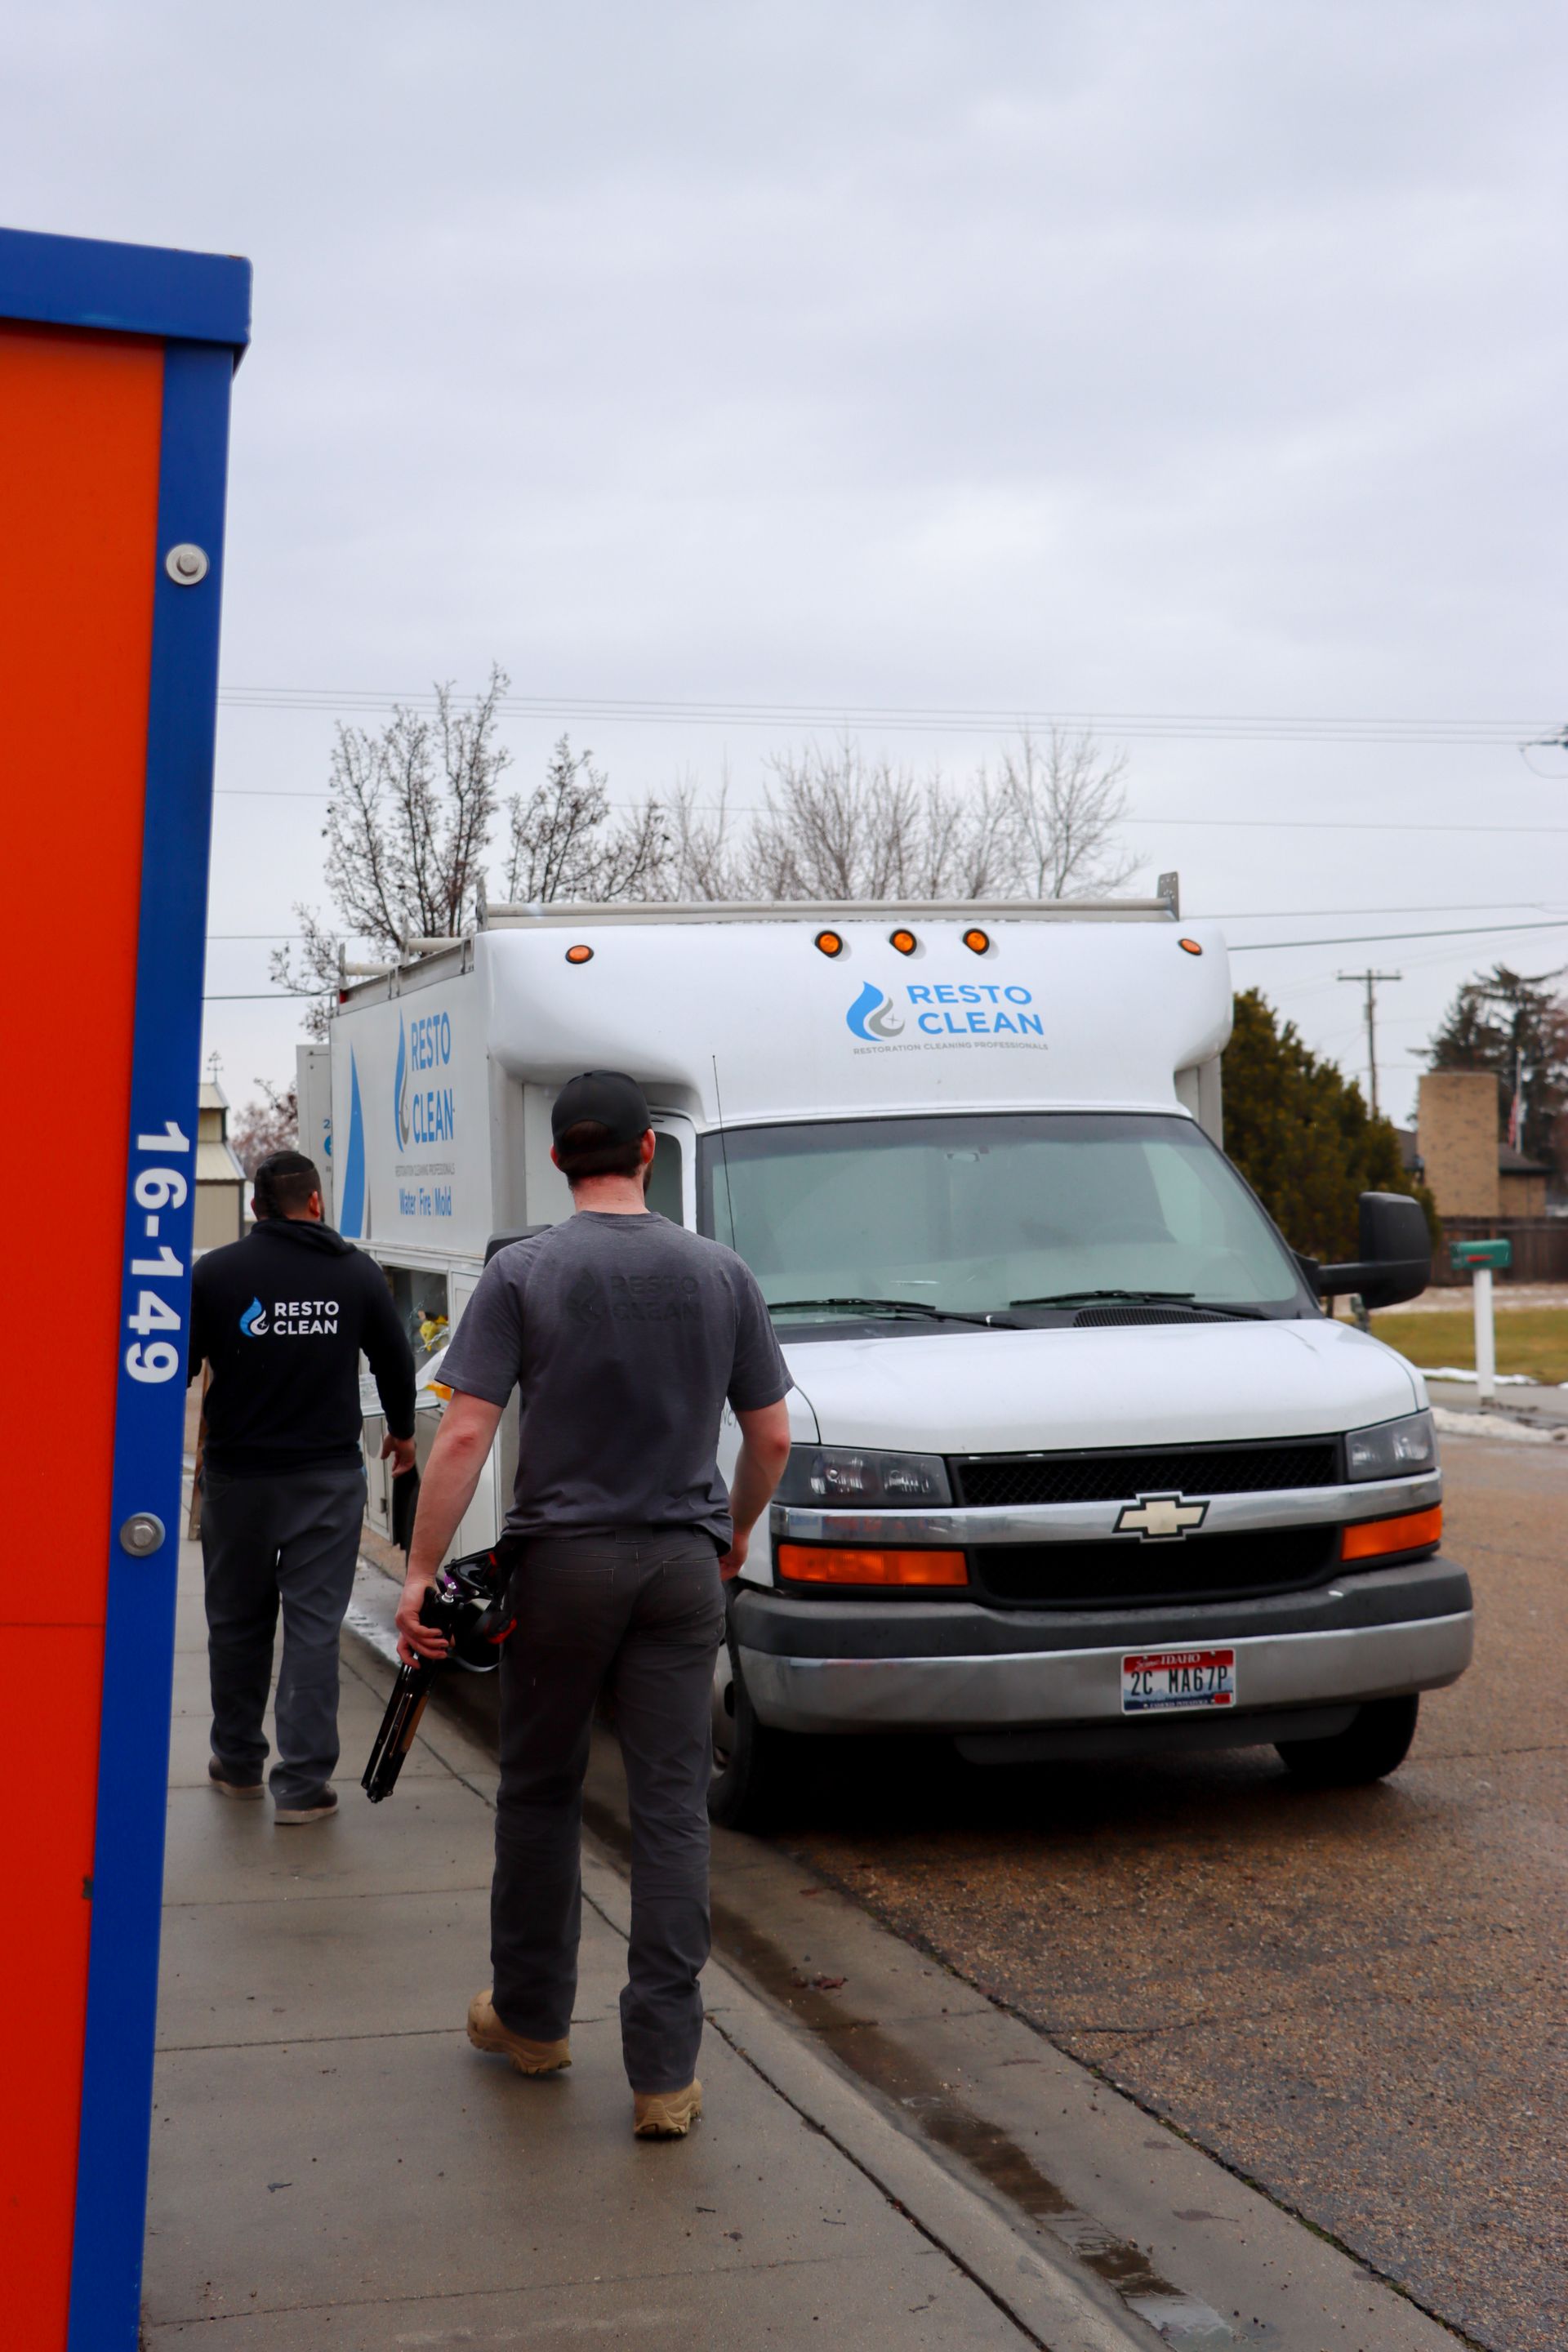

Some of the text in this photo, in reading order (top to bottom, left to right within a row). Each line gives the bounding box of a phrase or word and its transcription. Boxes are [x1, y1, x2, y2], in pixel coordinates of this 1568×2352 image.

[906, 985, 1032, 1005] RESTO
[918, 1012, 1045, 1036] CLEAN
[412, 1012, 452, 1071] RESTO
[853, 1040, 1049, 1055] RESTORATION CLEANING PROFESSIONALS
[412, 1089, 454, 1144] CLEAN
[399, 1185, 452, 1217] Water Fire Mold
[126, 1121, 190, 1383] 16-149
[610, 1276, 699, 1294] RESTO
[274, 1301, 340, 1316] RESTO
[612, 1302, 701, 1321] CLEAN
[274, 1320, 338, 1335] CLEAN
[1160, 1653, 1201, 1666] IDAHO
[1131, 1665, 1228, 1696] 2C MA67P
